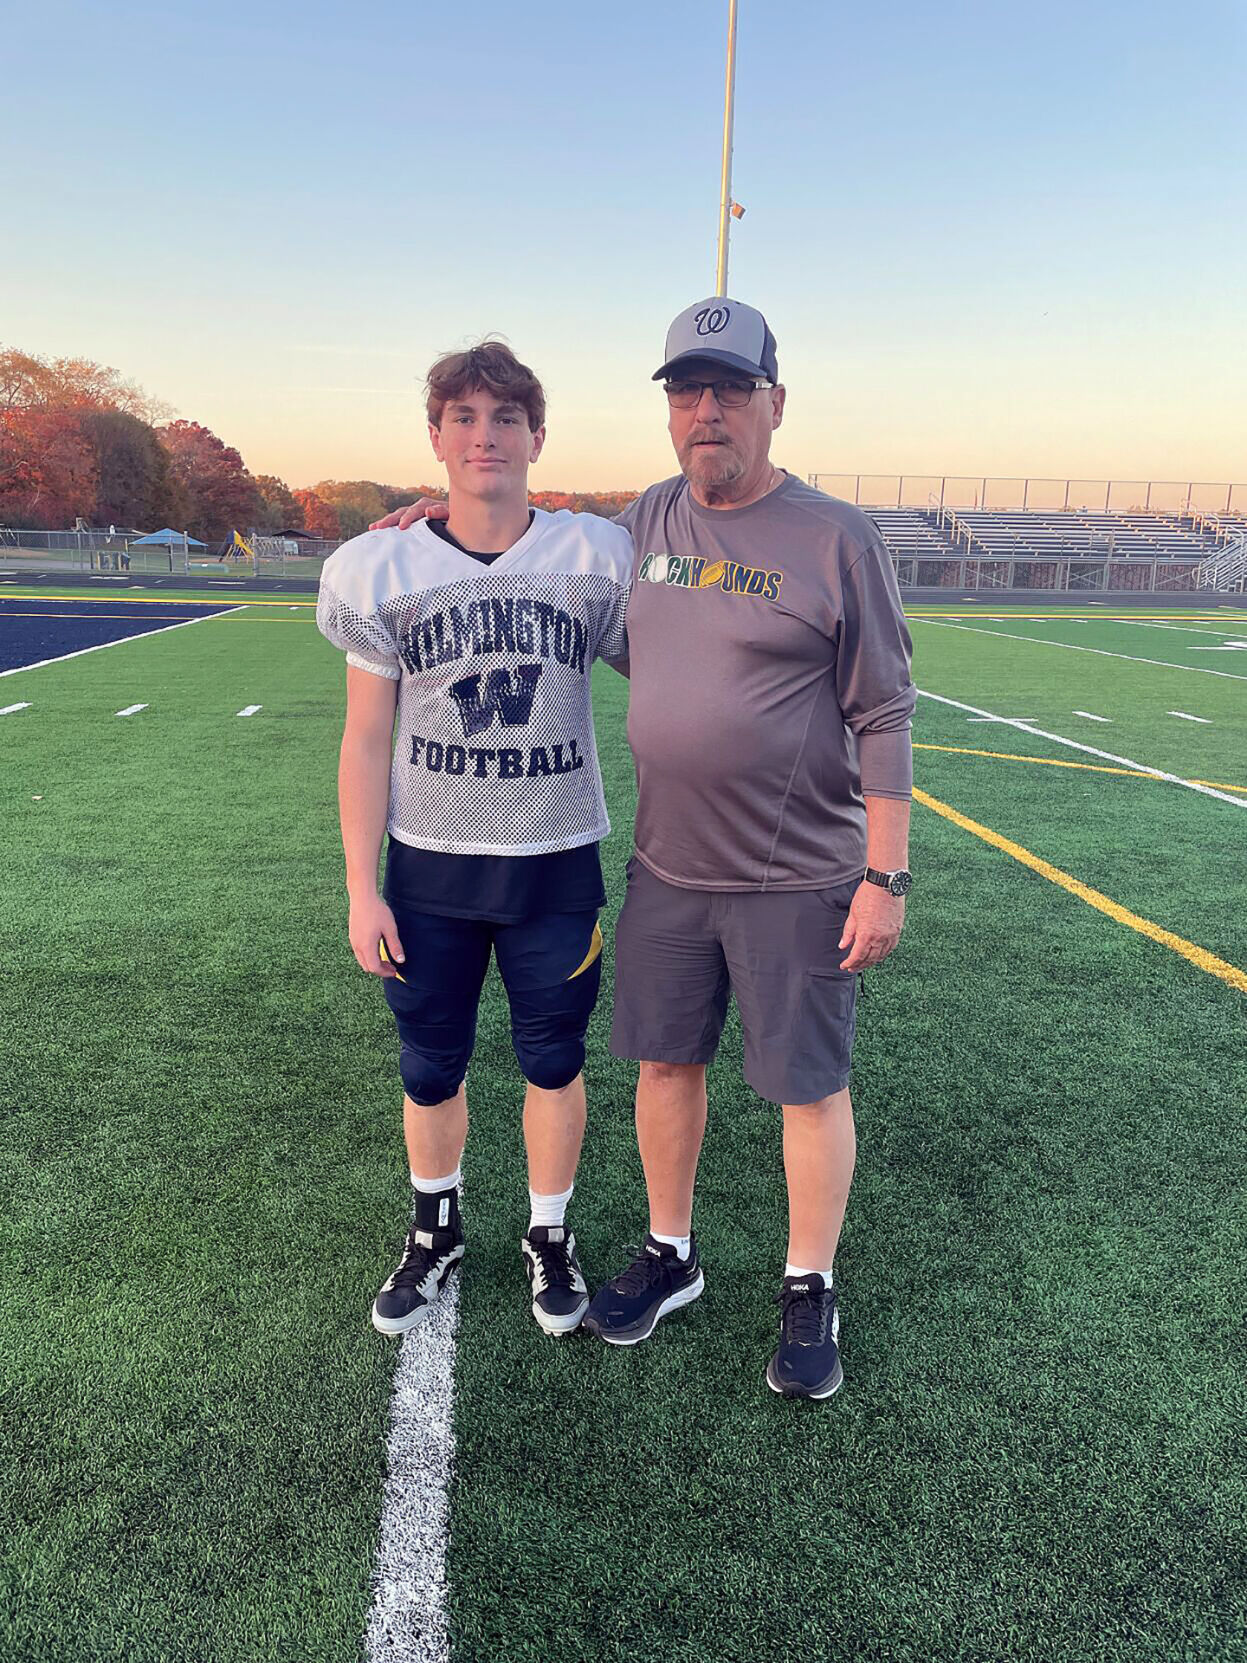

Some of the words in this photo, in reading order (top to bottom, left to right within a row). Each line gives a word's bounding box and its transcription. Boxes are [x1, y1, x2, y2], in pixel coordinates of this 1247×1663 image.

[694, 306, 731, 336] W
[401, 598, 588, 675] WILMINGTON
[450, 663, 543, 737] W
[410, 735, 583, 779] FOOTBALL
[790, 1283, 809, 1291] HOKA
